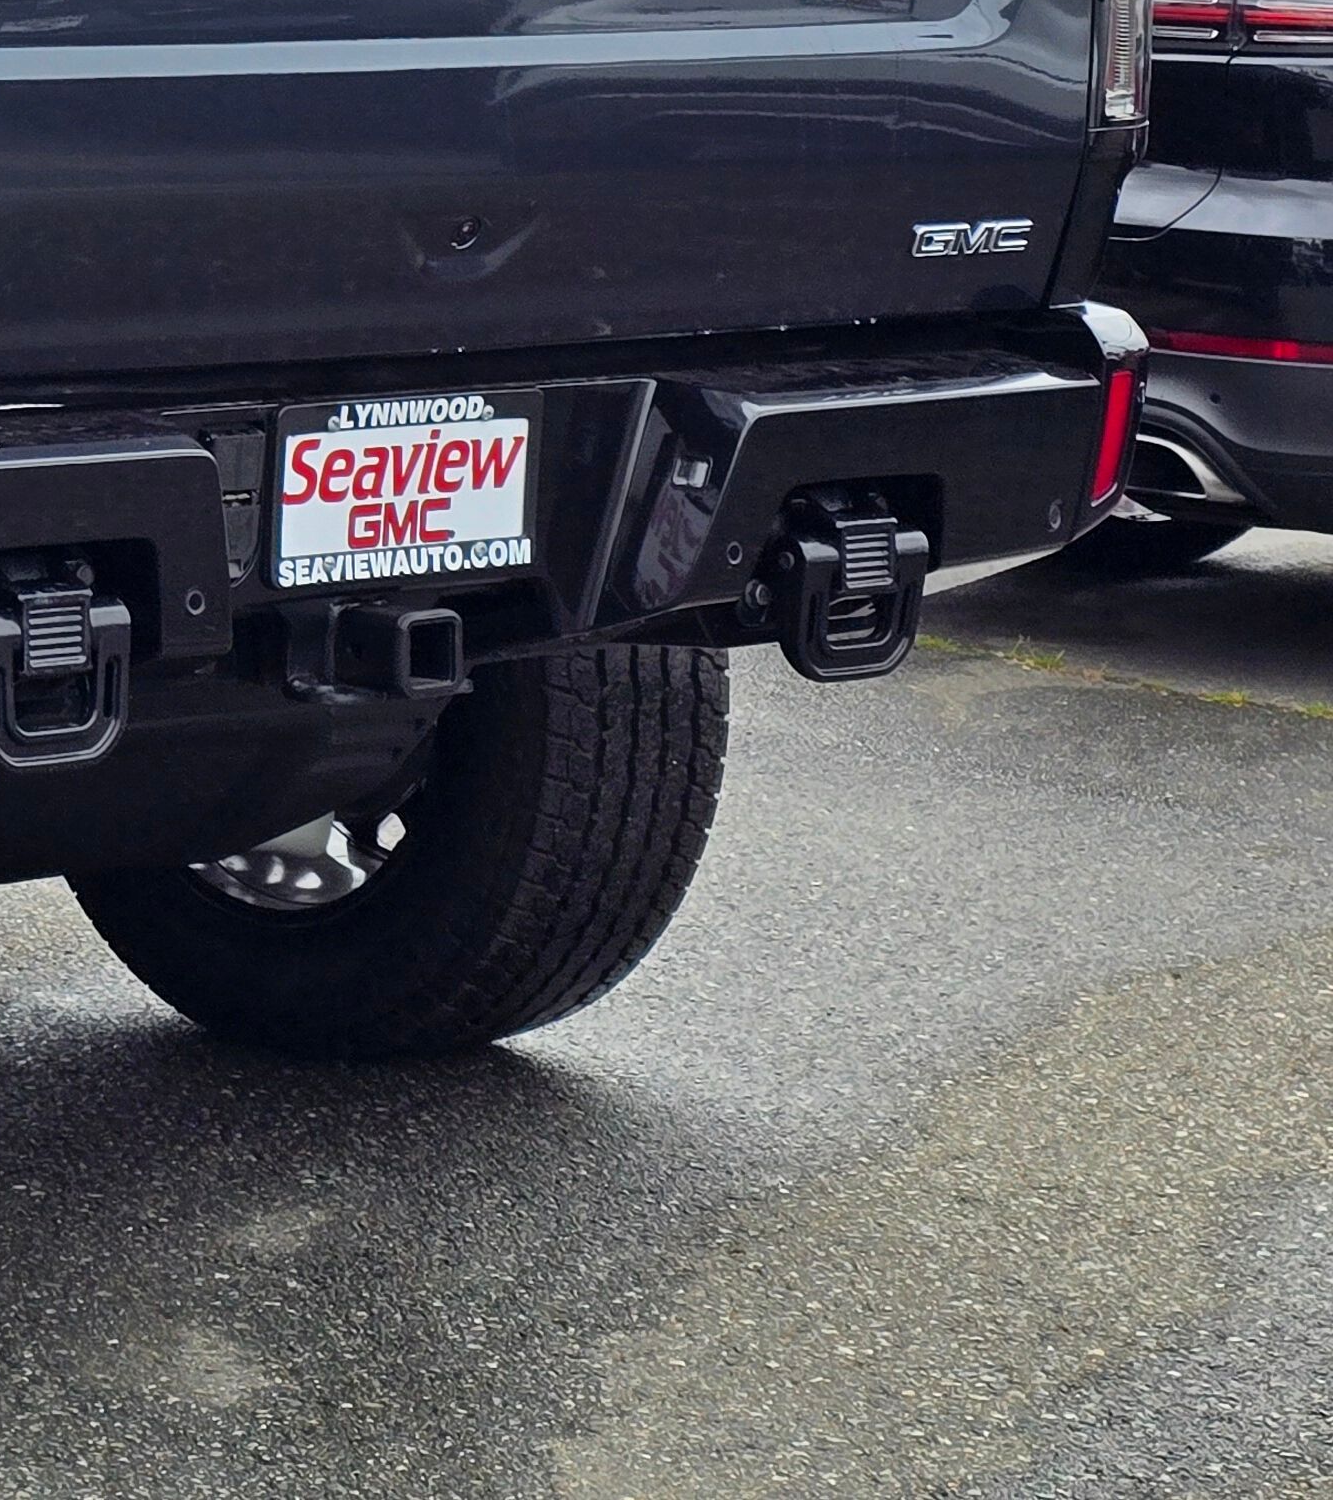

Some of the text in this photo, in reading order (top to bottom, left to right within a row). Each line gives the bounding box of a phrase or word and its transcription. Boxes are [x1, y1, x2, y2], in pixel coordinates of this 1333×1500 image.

[912, 218, 1034, 257] GMC
[339, 395, 485, 429] LYNNWOOD
[282, 429, 525, 505] Seaview
[347, 497, 455, 549] GMC
[278, 538, 532, 588] SEAVIEWAUTO.COM
